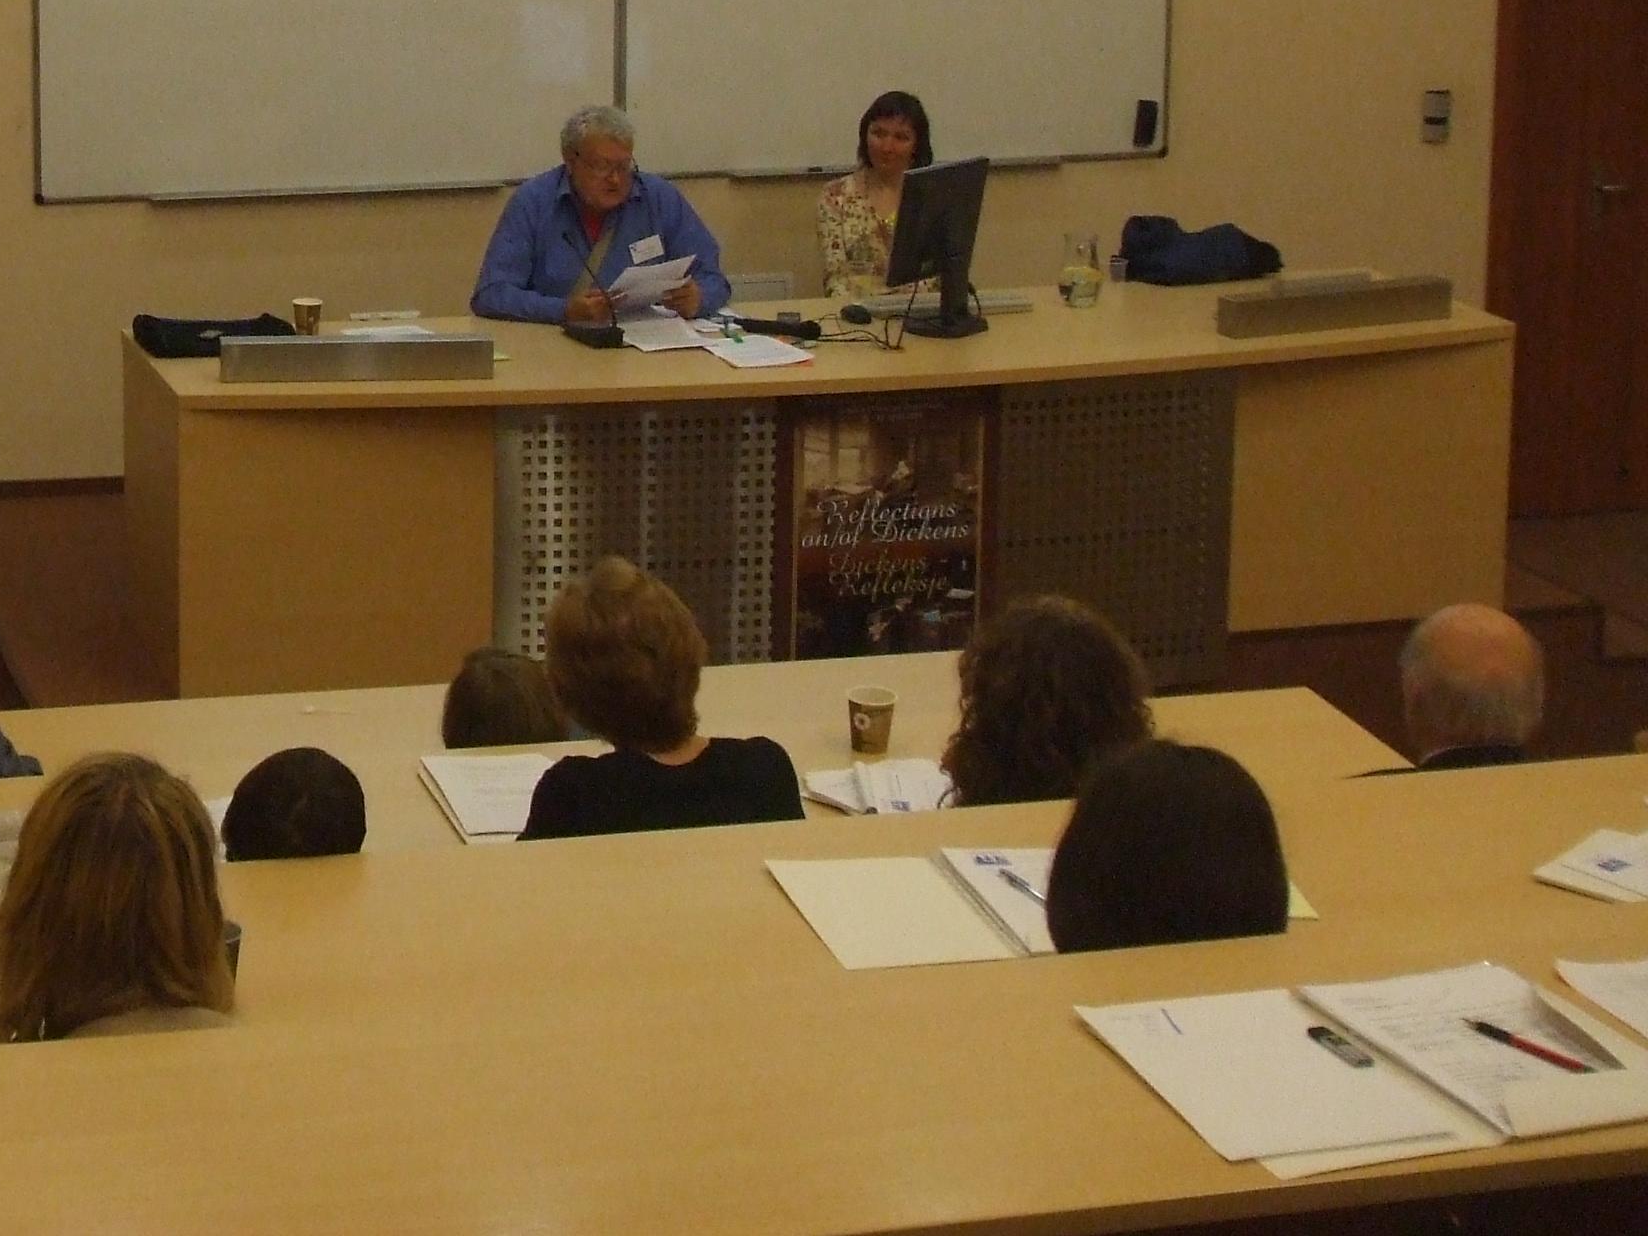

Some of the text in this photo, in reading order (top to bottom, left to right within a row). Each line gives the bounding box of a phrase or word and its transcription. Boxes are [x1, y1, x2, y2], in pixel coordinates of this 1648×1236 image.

[815, 498, 958, 526] Reflections
[801, 519, 970, 549] on/of Dickens
